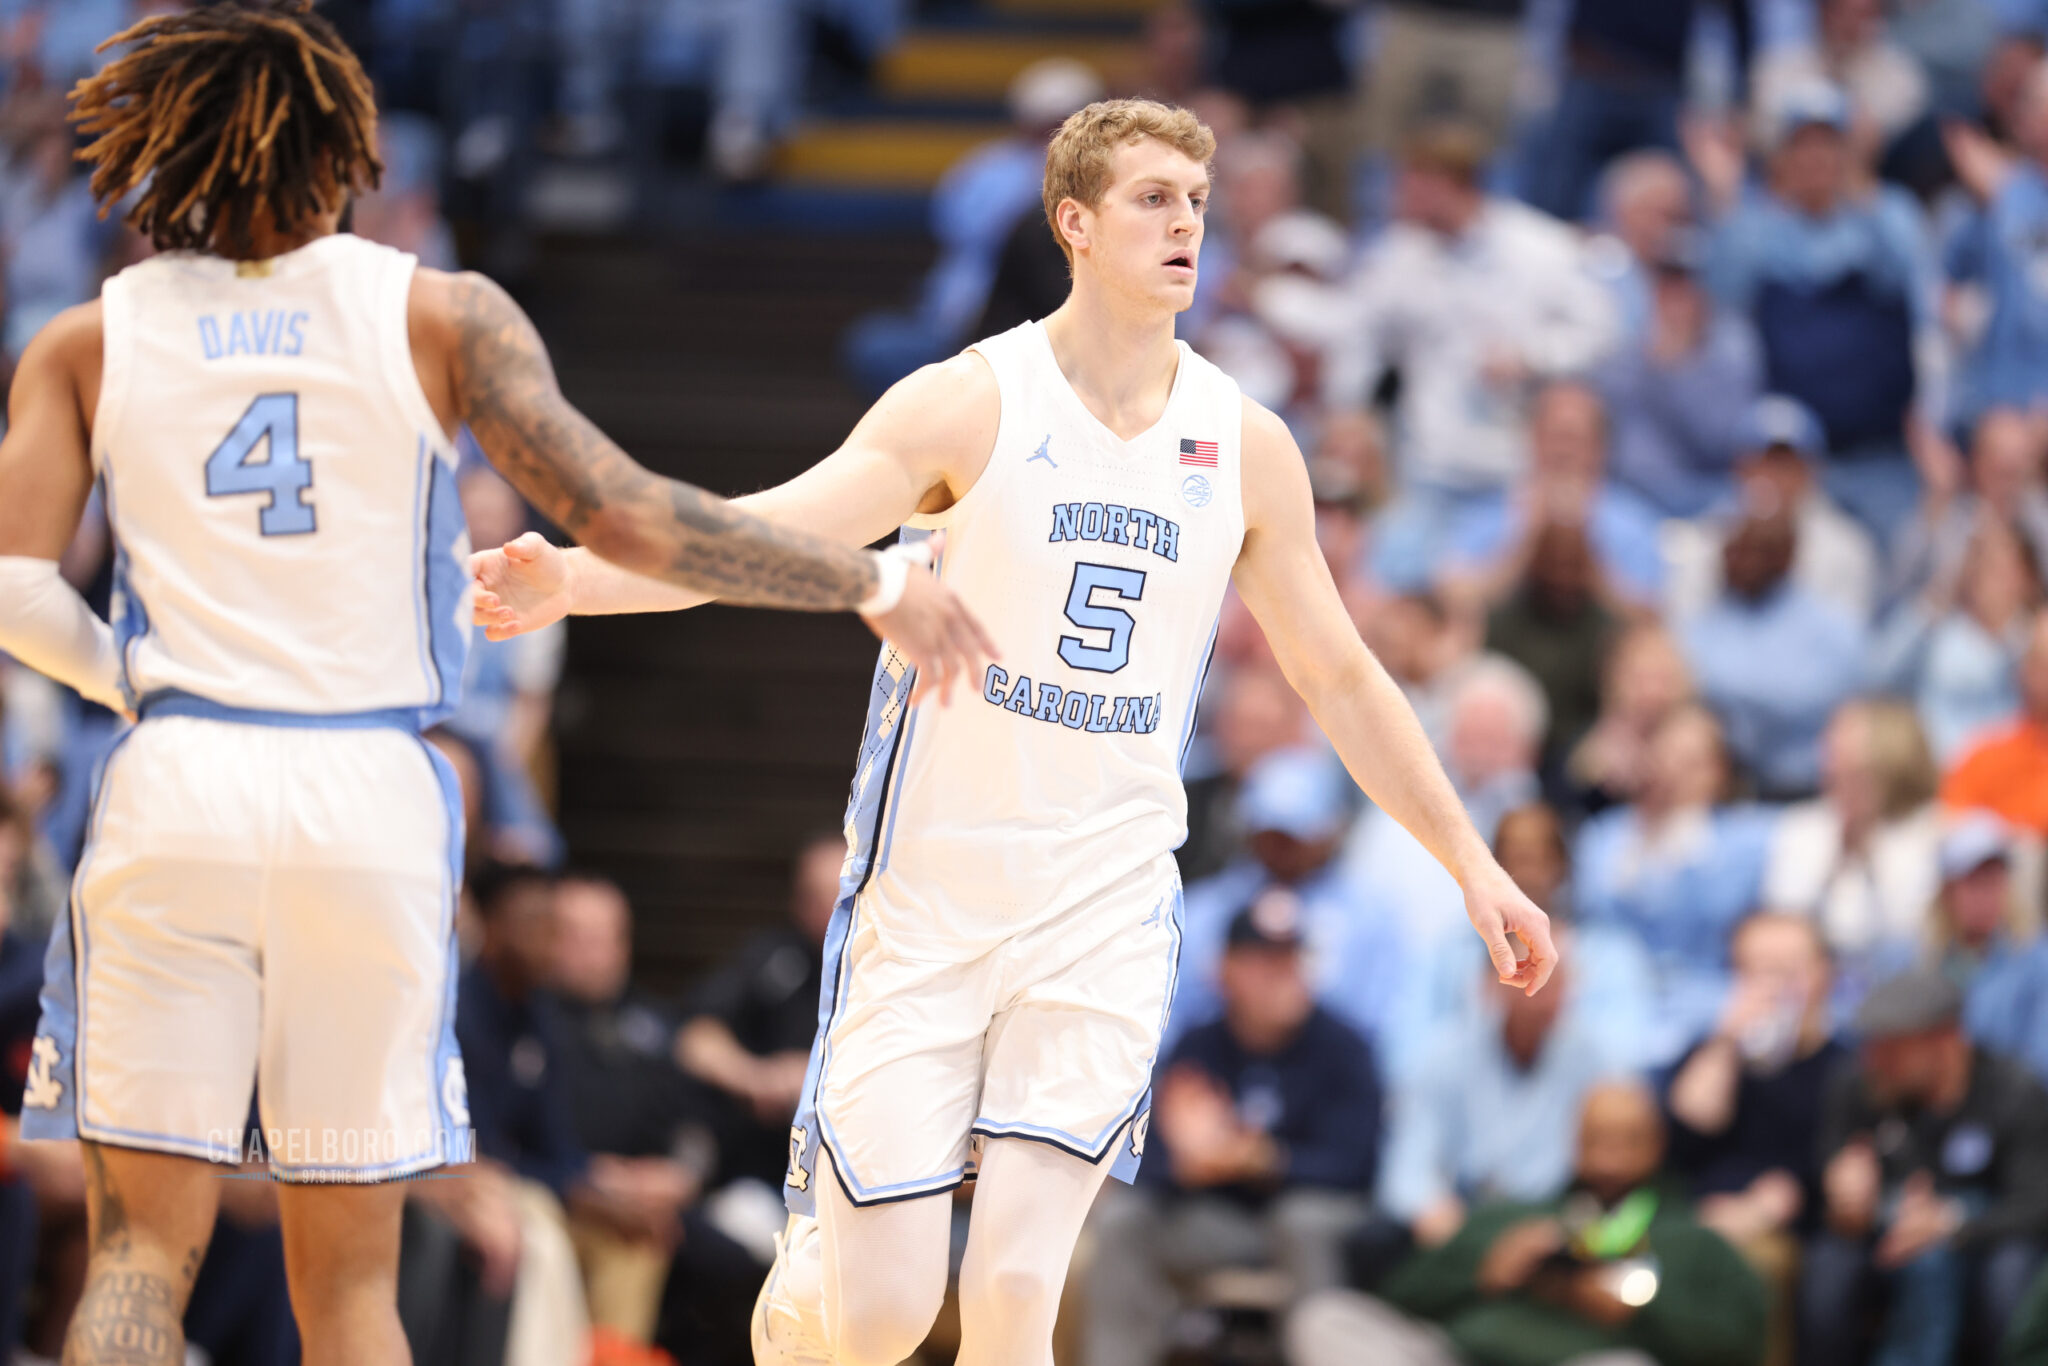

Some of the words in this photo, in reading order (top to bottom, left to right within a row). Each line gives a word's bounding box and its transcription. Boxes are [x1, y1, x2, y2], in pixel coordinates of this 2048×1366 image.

[197, 309, 311, 360] DAVIS
[205, 391, 317, 537] 4
[1049, 502, 1180, 563] NORTH
[1057, 561, 1147, 674] 5
[983, 663, 1162, 734] CAROLINA
[89, 1319, 168, 1358] YOU
